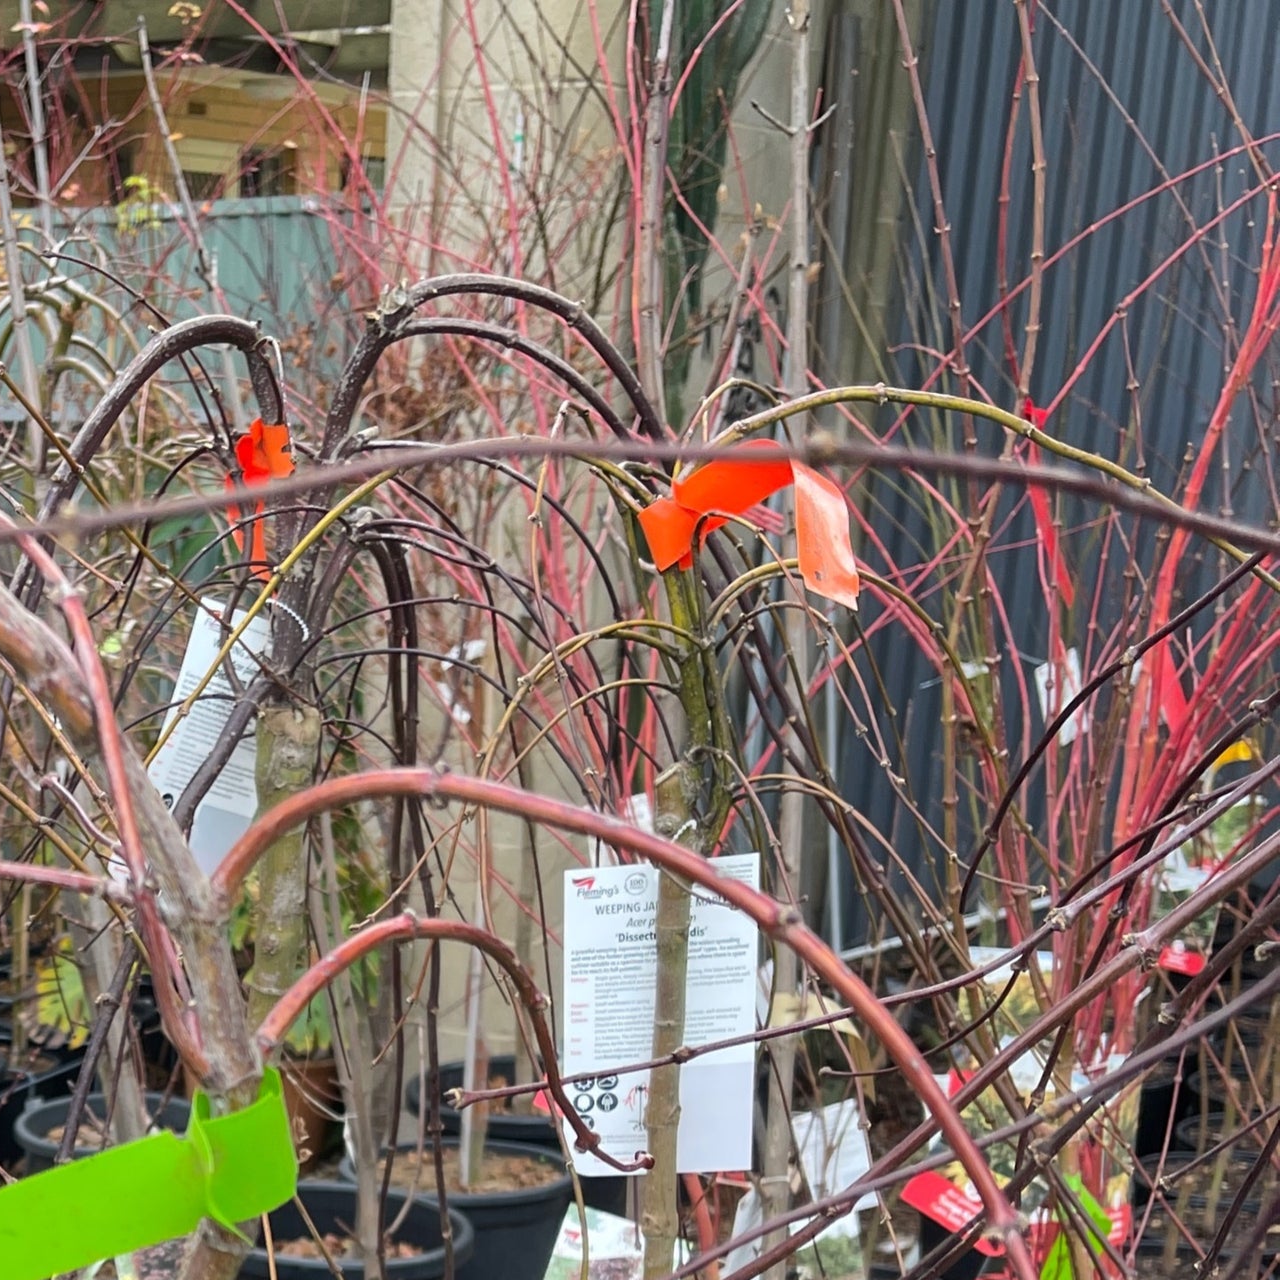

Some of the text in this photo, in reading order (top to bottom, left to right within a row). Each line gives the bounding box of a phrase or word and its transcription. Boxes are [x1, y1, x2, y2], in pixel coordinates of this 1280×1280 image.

[576, 885, 619, 898] Fleming's
[595, 902, 641, 915] WEEPING
[626, 917, 646, 928] Acer
